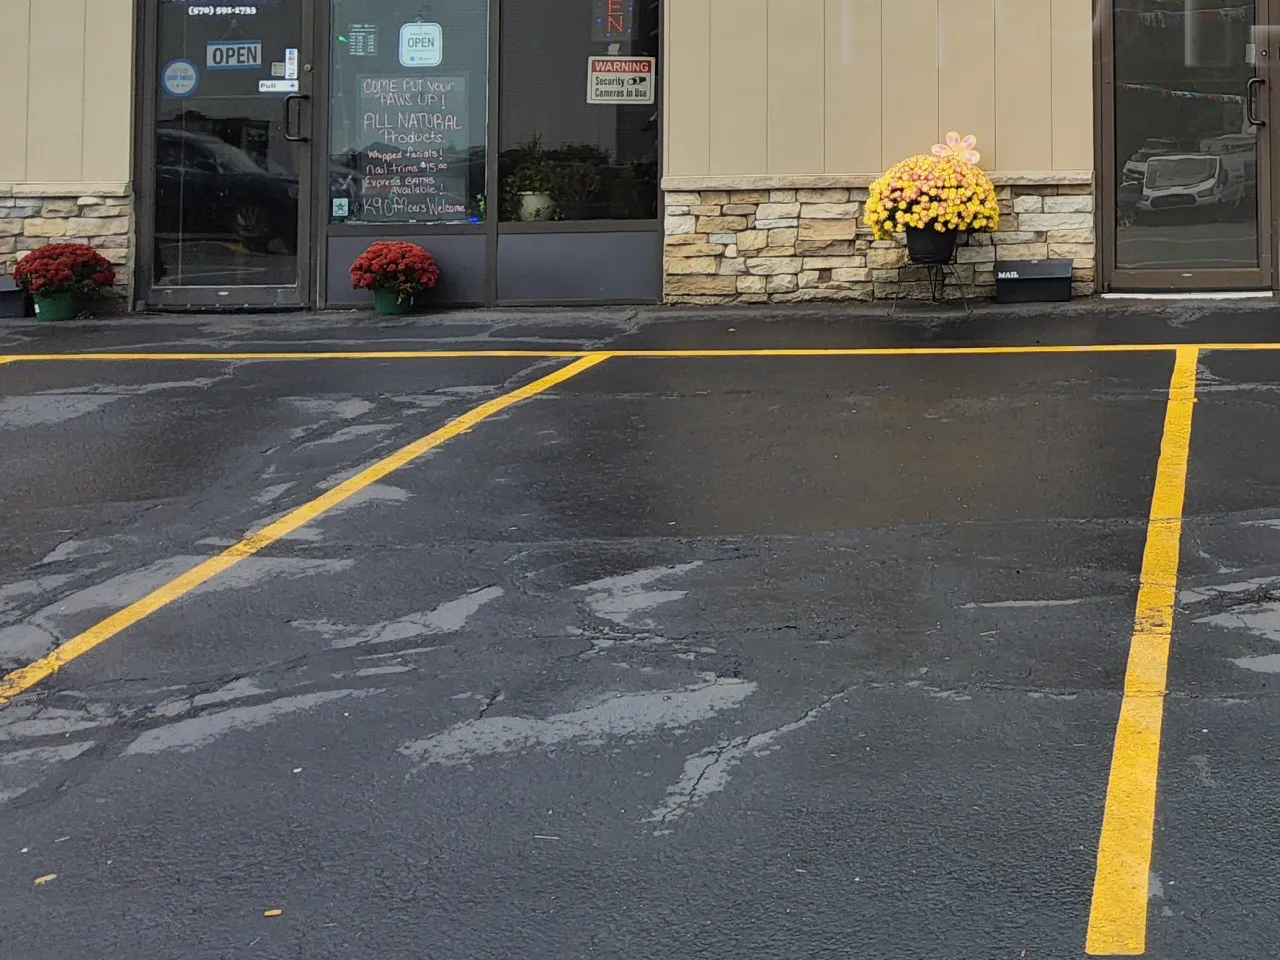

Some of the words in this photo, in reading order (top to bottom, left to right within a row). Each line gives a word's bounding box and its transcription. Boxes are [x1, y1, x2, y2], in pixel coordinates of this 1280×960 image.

[188, 6, 215, 16] (570)
[216, 6, 257, 15] 591-1733
[407, 37, 435, 48] OPEN
[212, 46, 258, 65] OPEN
[594, 61, 649, 72] WARNING
[363, 78, 398, 93] COME
[403, 78, 424, 92] PUT
[595, 76, 625, 88] Security
[595, 88, 624, 98] Cameras
[626, 88, 633, 97] In
[635, 88, 647, 98] Use
[375, 93, 412, 106] PAWS
[363, 112, 393, 129] ALL
[398, 112, 463, 130] NATURAL
[378, 129, 442, 144] Products
[367, 149, 402, 161] Whipped
[364, 176, 401, 188] Express
[405, 176, 436, 186] BATHS
[363, 197, 383, 216] K9
[384, 197, 427, 216] Officers
[427, 197, 466, 216] Welcome
[998, 271, 1019, 279] MAIL
